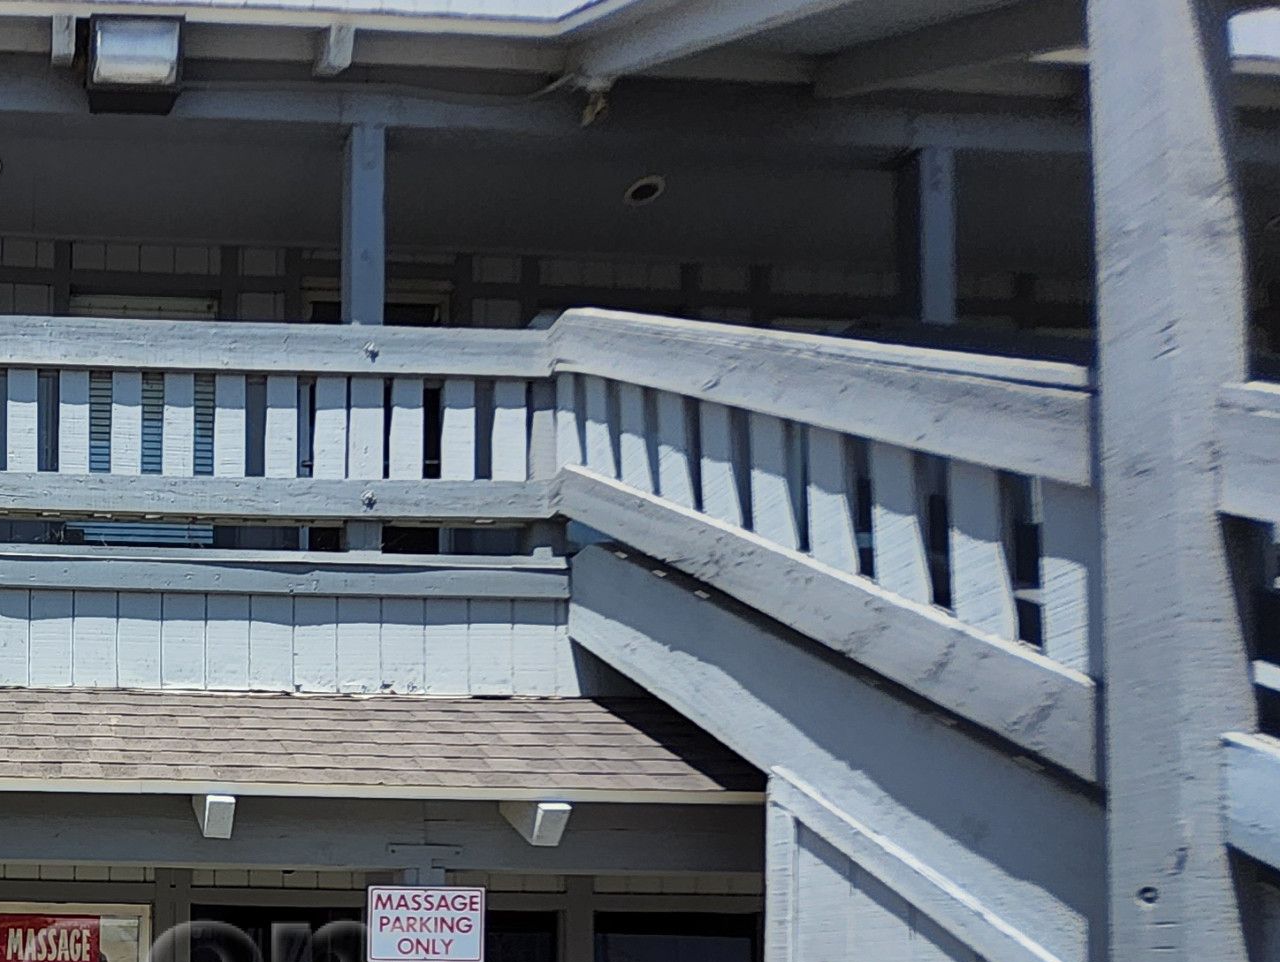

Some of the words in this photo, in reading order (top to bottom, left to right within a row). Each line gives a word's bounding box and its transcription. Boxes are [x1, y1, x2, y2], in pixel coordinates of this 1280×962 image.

[374, 893, 480, 912] MASSAGE
[379, 916, 473, 934] PARKING
[6, 927, 91, 962] MASSAGE
[397, 938, 454, 955] ONLY
